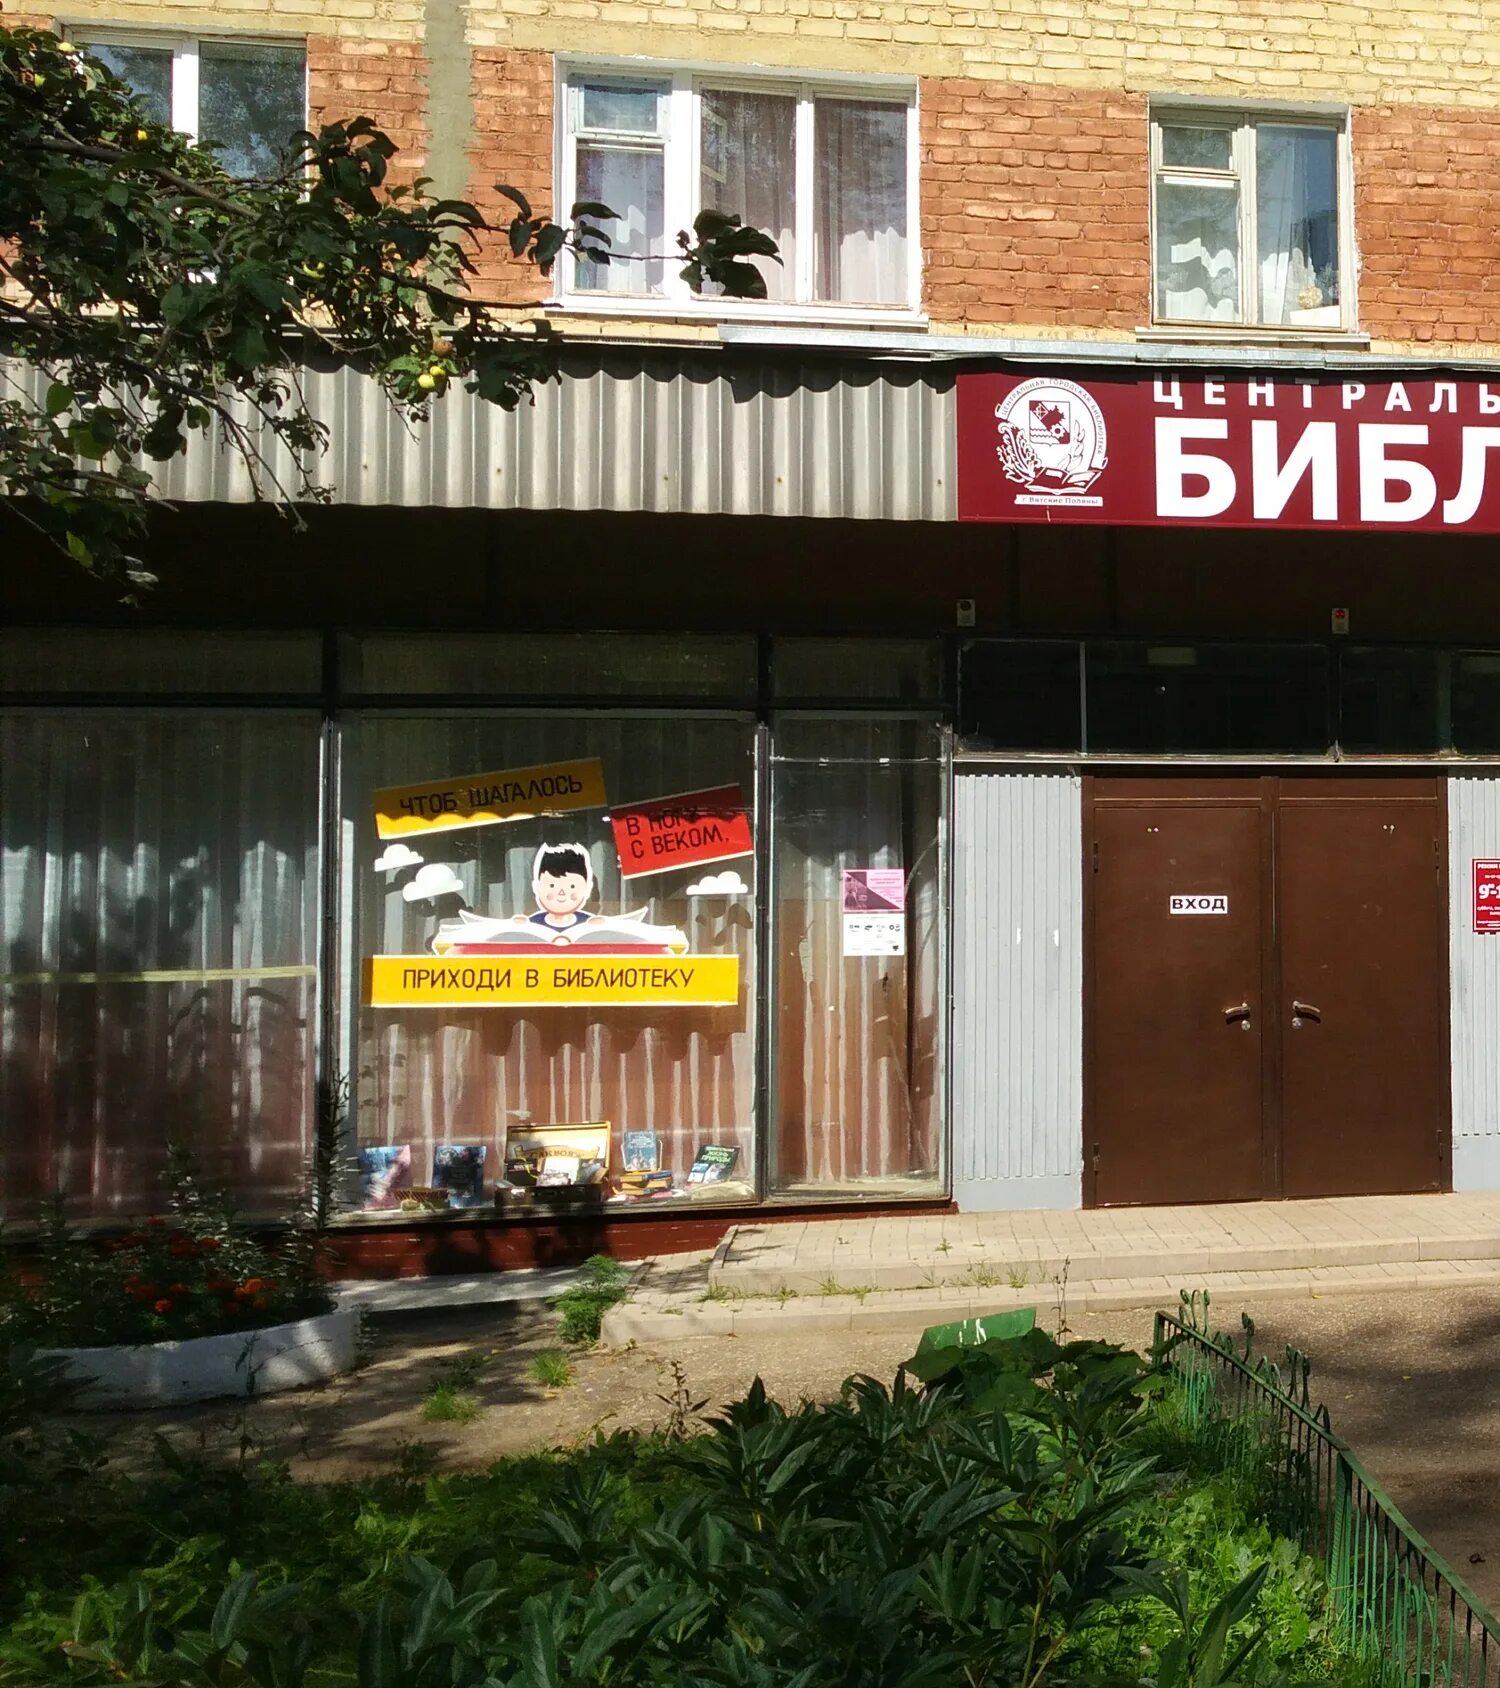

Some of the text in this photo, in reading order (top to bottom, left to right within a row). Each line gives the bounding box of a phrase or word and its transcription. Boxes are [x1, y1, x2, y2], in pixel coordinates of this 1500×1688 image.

[1001, 379, 1045, 416] ЦЕНТРАЛЬНАЯ
[1090, 404, 1104, 455] БИБЛИОТЕКА
[400, 775, 583, 816] ЧТОБ ШАГАЛОСЬ
[625, 816, 641, 837] В
[630, 840, 645, 859] С
[1172, 898, 1225, 911] ВХОД
[403, 968, 694, 991] ПРИХОДИ В БИБЛИОТЕКУ
